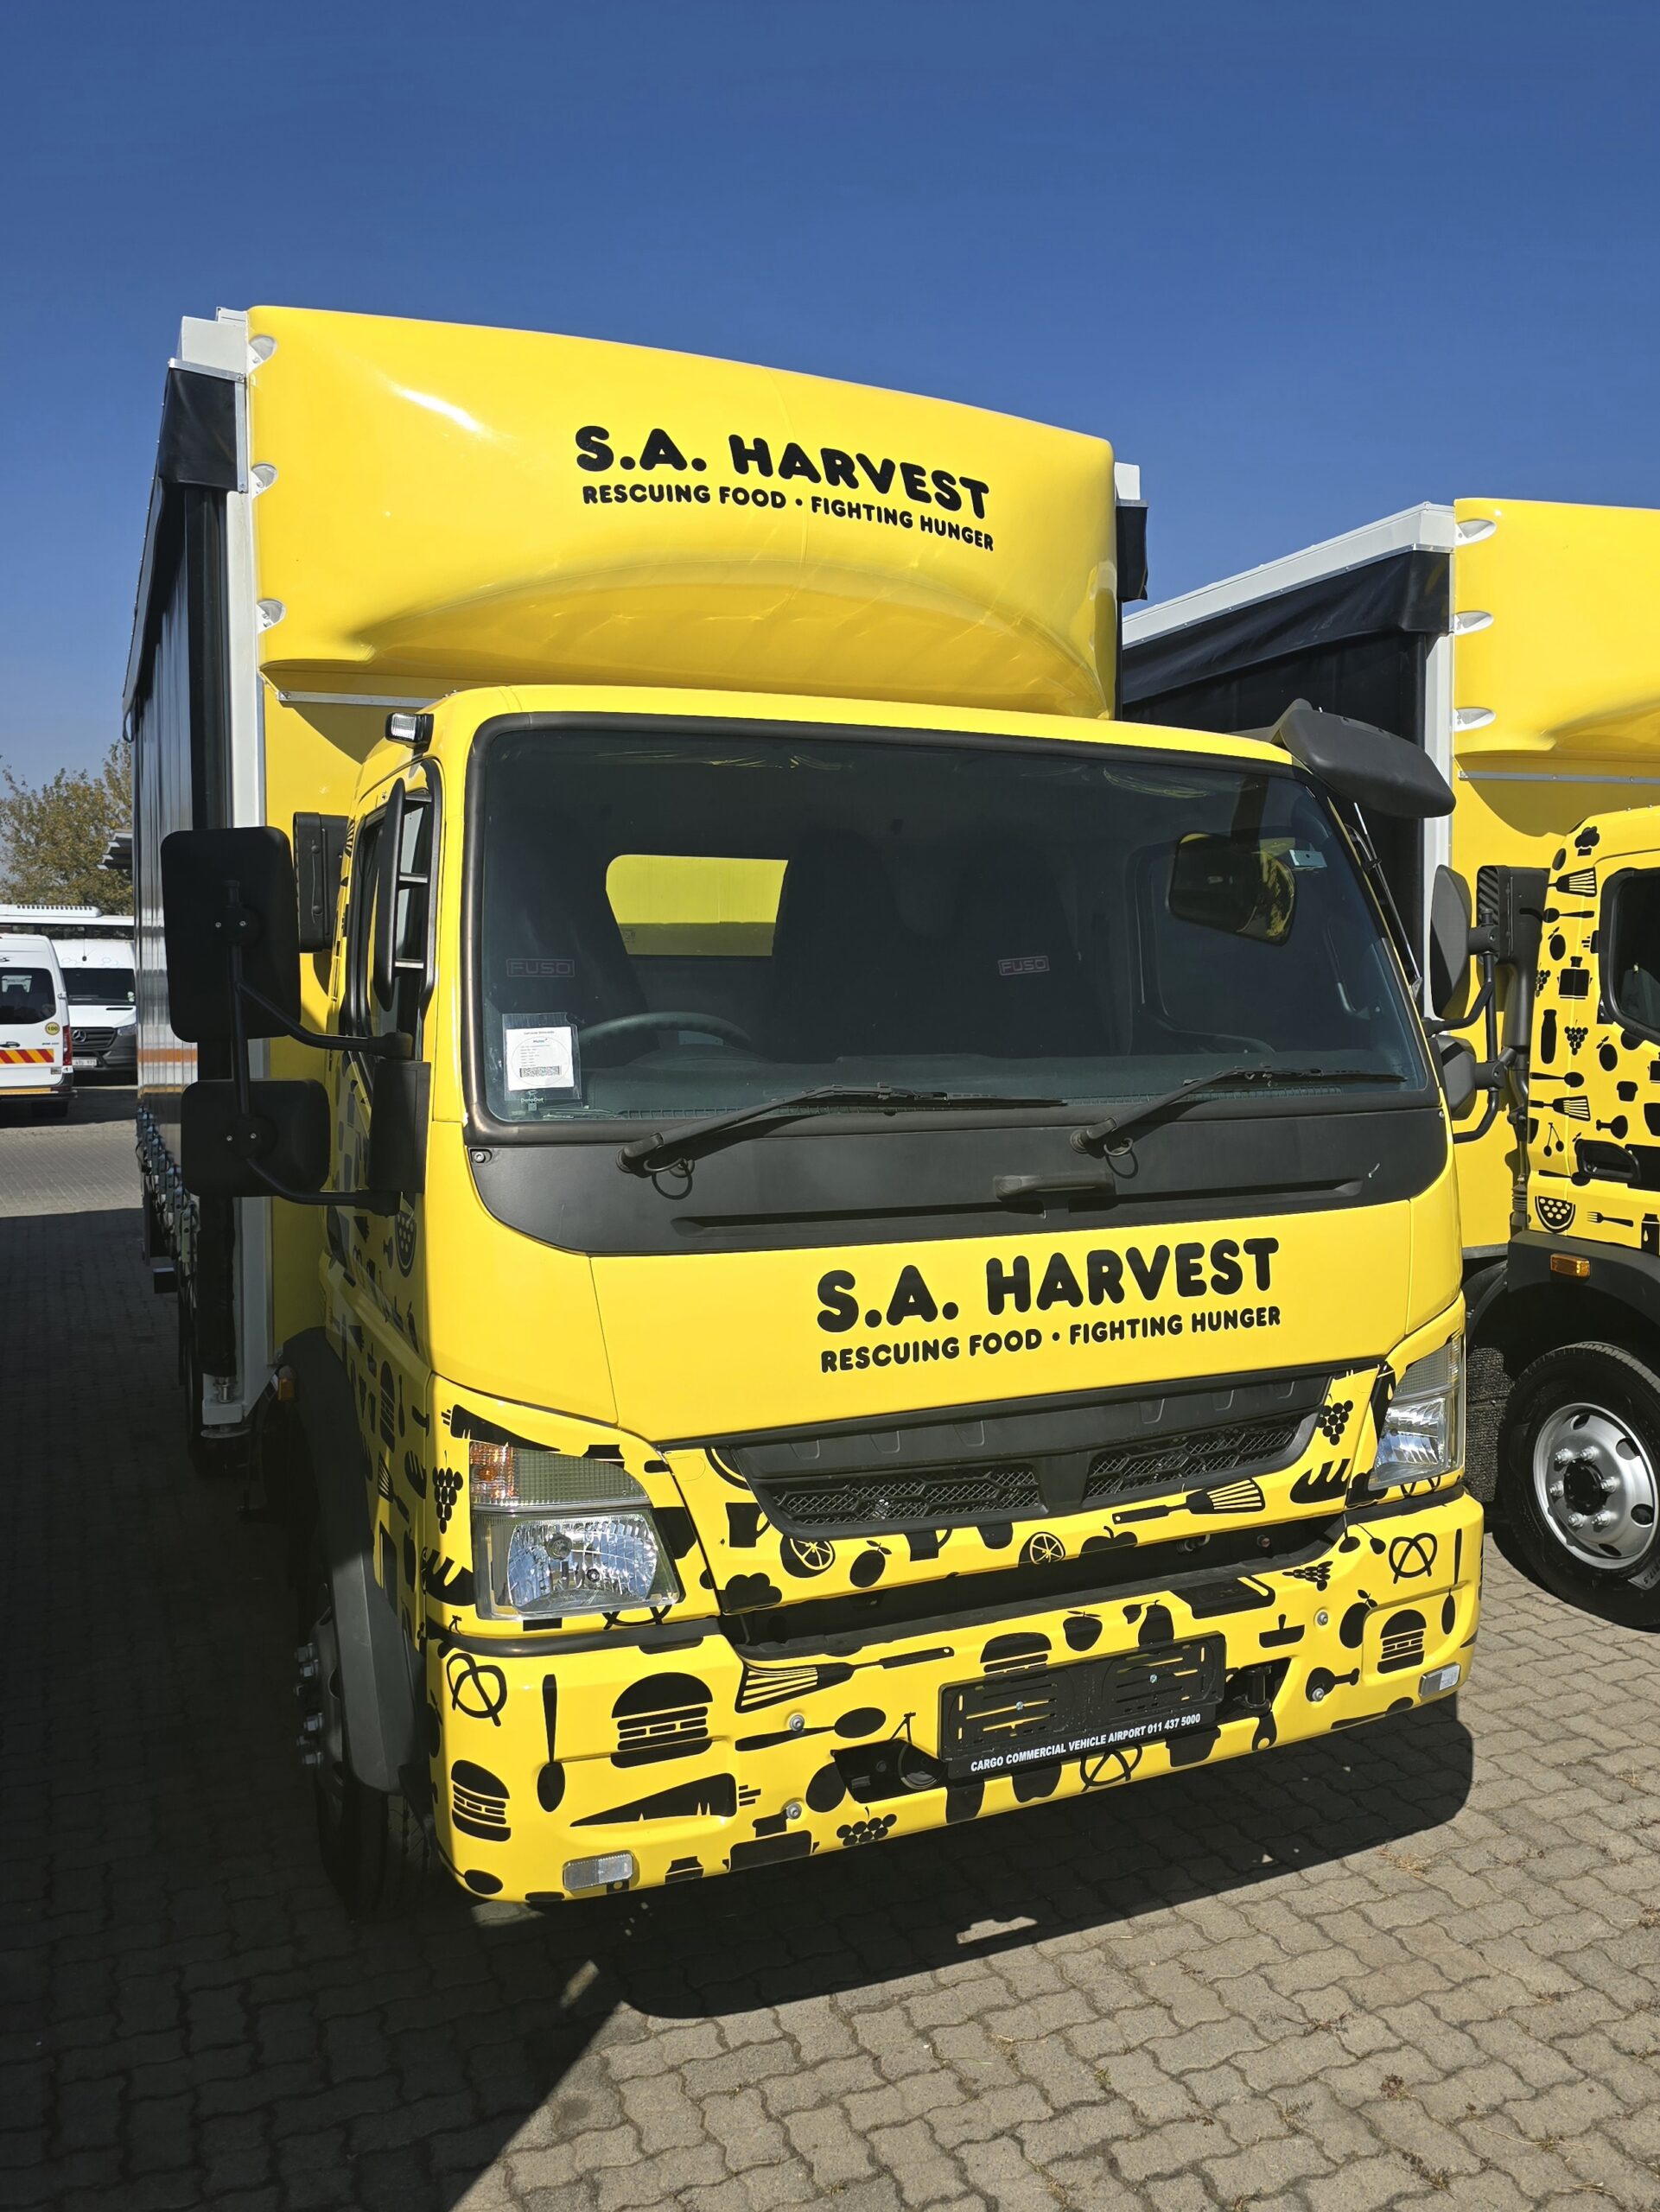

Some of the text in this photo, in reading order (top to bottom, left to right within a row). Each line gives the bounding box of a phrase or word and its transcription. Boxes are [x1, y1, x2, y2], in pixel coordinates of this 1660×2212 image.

[576, 426, 989, 519] S.A. HARVEST
[582, 484, 994, 552] RESCUING FOOD FIGHTING HUNGER
[510, 962, 571, 975] FUSO
[1002, 959, 1046, 973] FUSO
[817, 1237, 1280, 1333] S.A. HARVEST
[821, 1306, 1281, 1374] RESCUING FOOD FIGHTING HUNGER
[970, 1713, 1201, 1772] CARGO COMMERCIAL VEHICLE AIRPORT 011 437 5000
